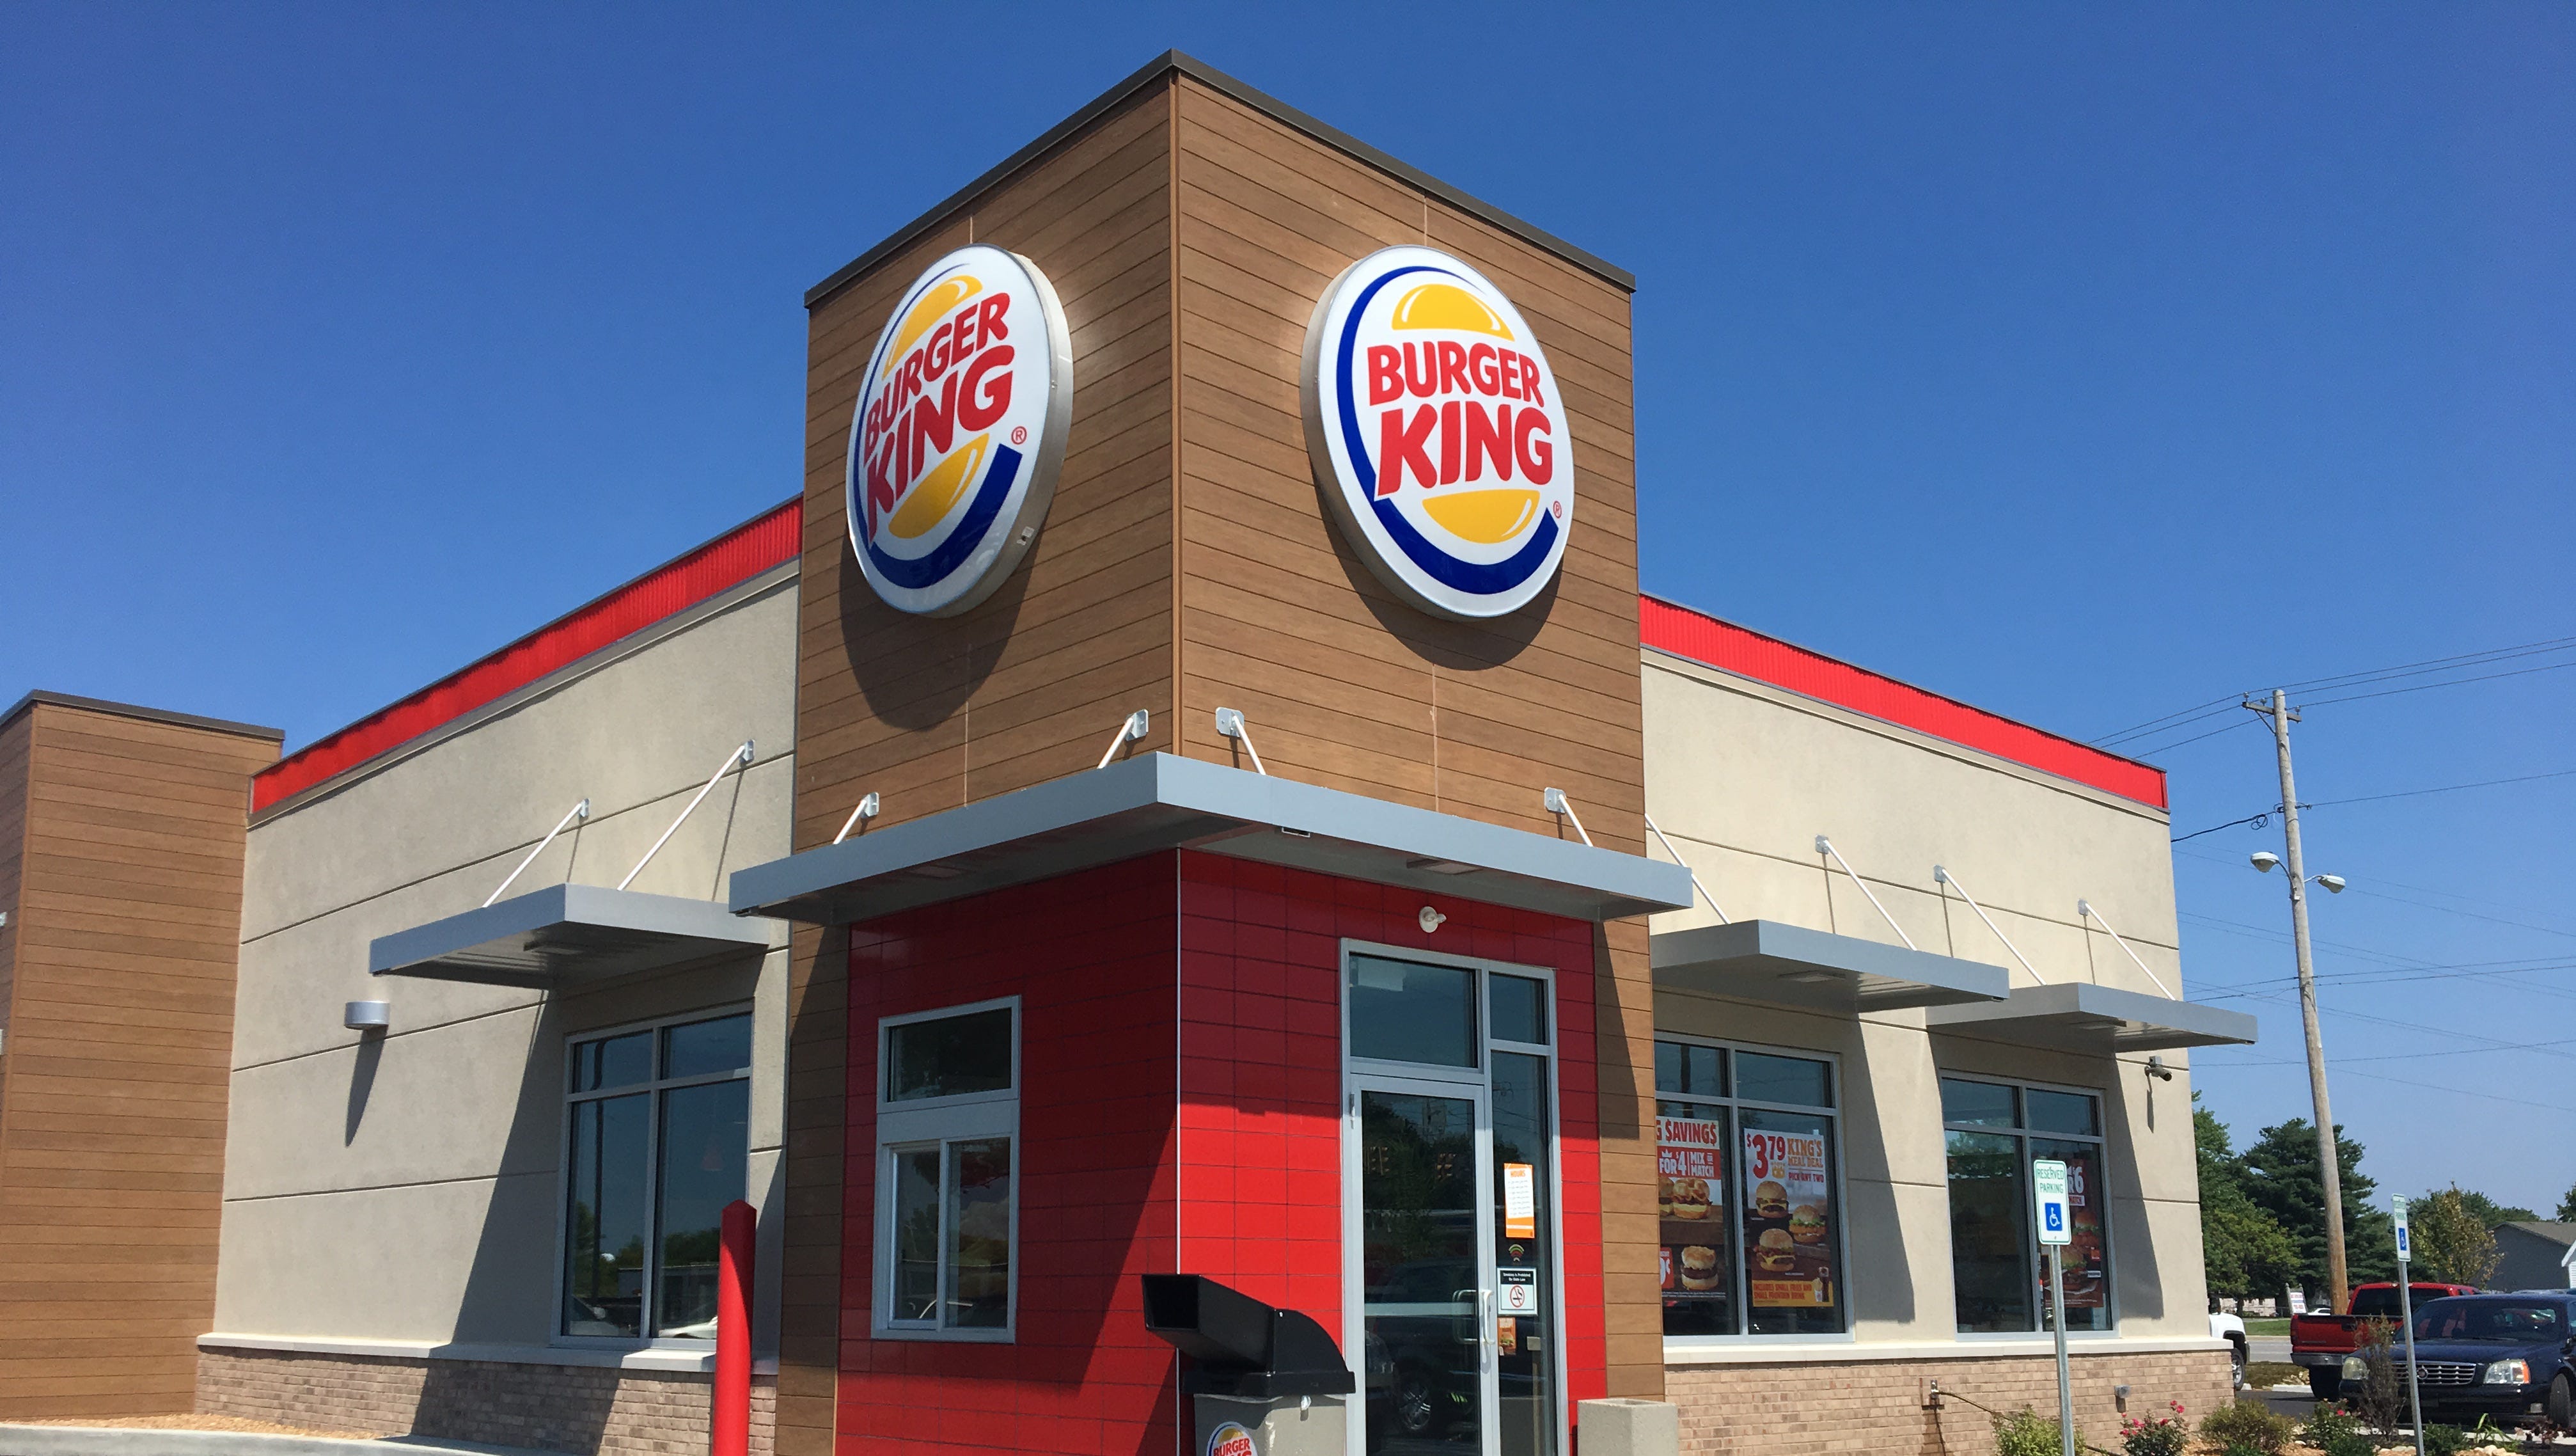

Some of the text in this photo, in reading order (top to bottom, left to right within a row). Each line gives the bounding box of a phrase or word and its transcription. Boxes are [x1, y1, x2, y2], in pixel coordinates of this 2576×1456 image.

[863, 292, 1009, 469] BURGER
[1367, 341, 1544, 408] BURGER
[867, 345, 1015, 544] KING
[1378, 401, 1553, 496] KING
[1787, 1138, 1822, 1157] KING'S
[1659, 1158, 1677, 1174] FOR
[1690, 1151, 1705, 1164] MIX
[1691, 1164, 1714, 1177] MATCH
[2036, 1168, 2064, 1180] RESERVED
[2039, 1183, 2063, 1194] PARKING
[1213, 1437, 1250, 1456] BURGER
